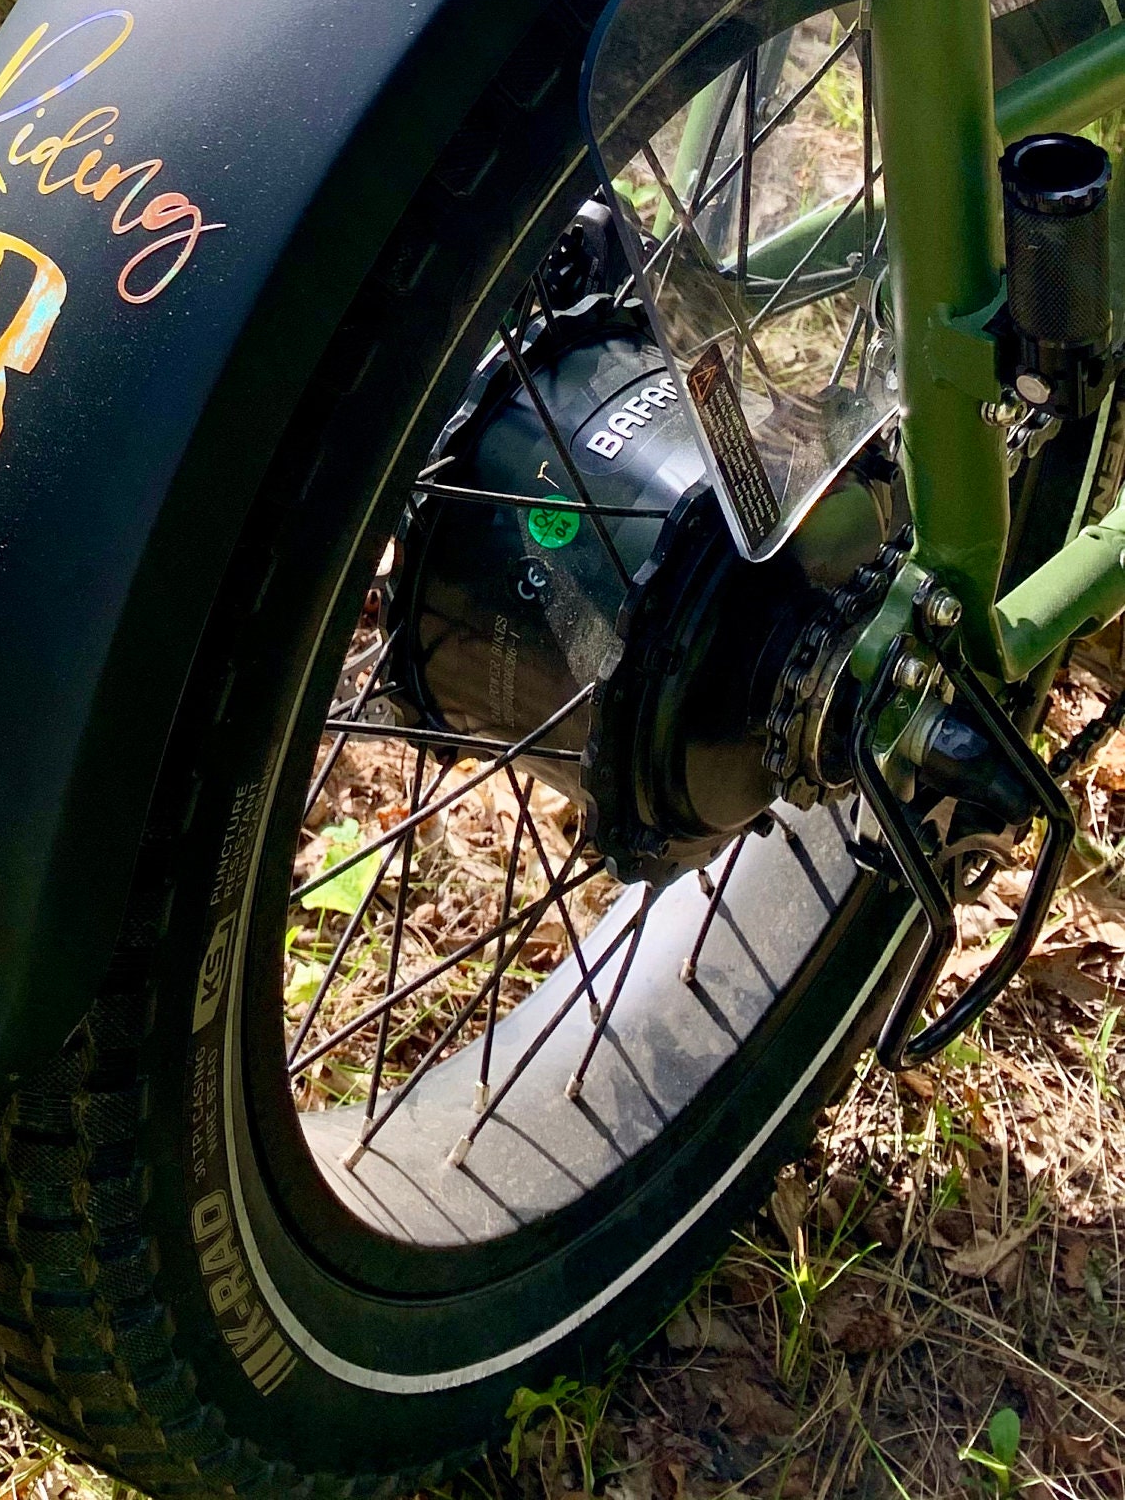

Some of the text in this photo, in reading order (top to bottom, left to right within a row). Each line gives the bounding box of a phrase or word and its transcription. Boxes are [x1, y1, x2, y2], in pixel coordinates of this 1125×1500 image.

[491, 615, 508, 657] BIKES
[210, 784, 249, 906] PUNCTURE
[223, 781, 260, 898] RESISTANT
[192, 1046, 206, 1184] 30 TPI CASING
[206, 1048, 218, 1157] WIRE BEAD
[192, 1189, 271, 1358] K-RAD
